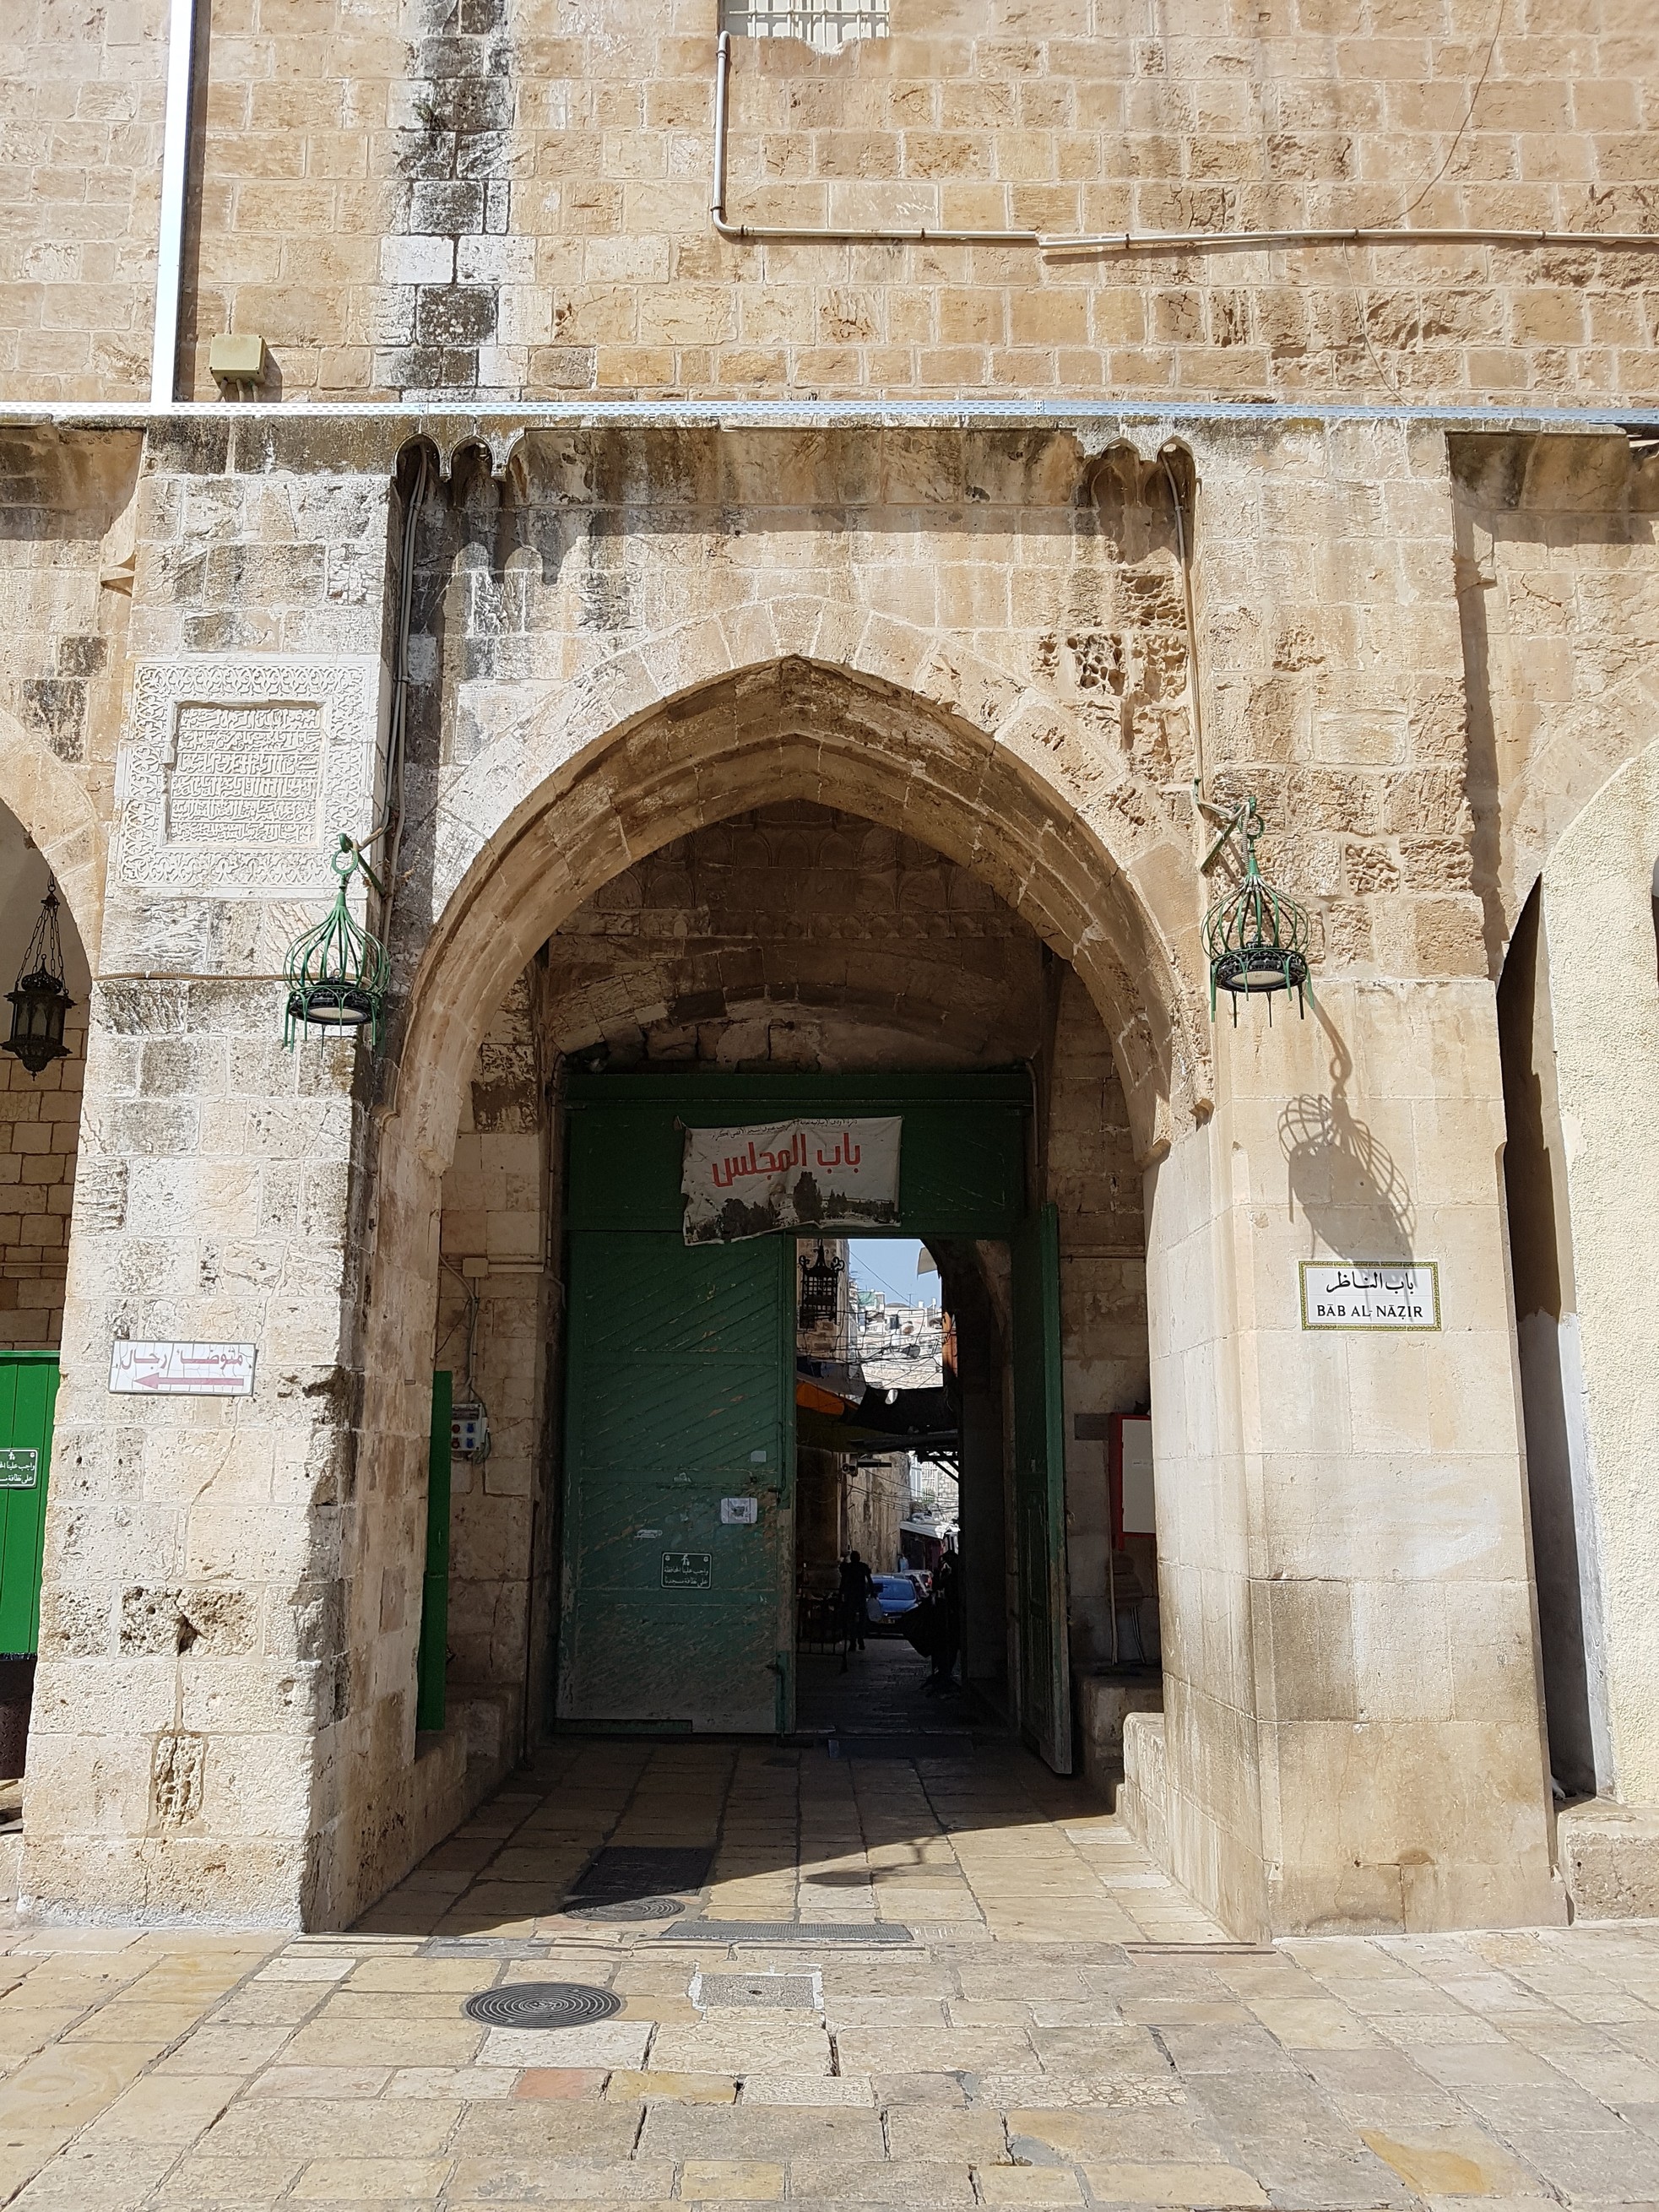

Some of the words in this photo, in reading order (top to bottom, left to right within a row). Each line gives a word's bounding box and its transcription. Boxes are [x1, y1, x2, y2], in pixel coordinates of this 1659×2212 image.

[816, 1132, 860, 1174] باب
[712, 1133, 807, 1188] المجلس
[1326, 1271, 1383, 1293] الناظر
[1385, 1272, 1414, 1294] باب
[121, 1348, 167, 1370] رجال
[6, 1461, 18, 1471] علينا
[18, 1461, 35, 1472] واجب
[21, 1473, 34, 1484] على
[681, 1565, 692, 1575] علينا
[692, 1568, 709, 1576] واجب
[697, 1577, 708, 1588] على
